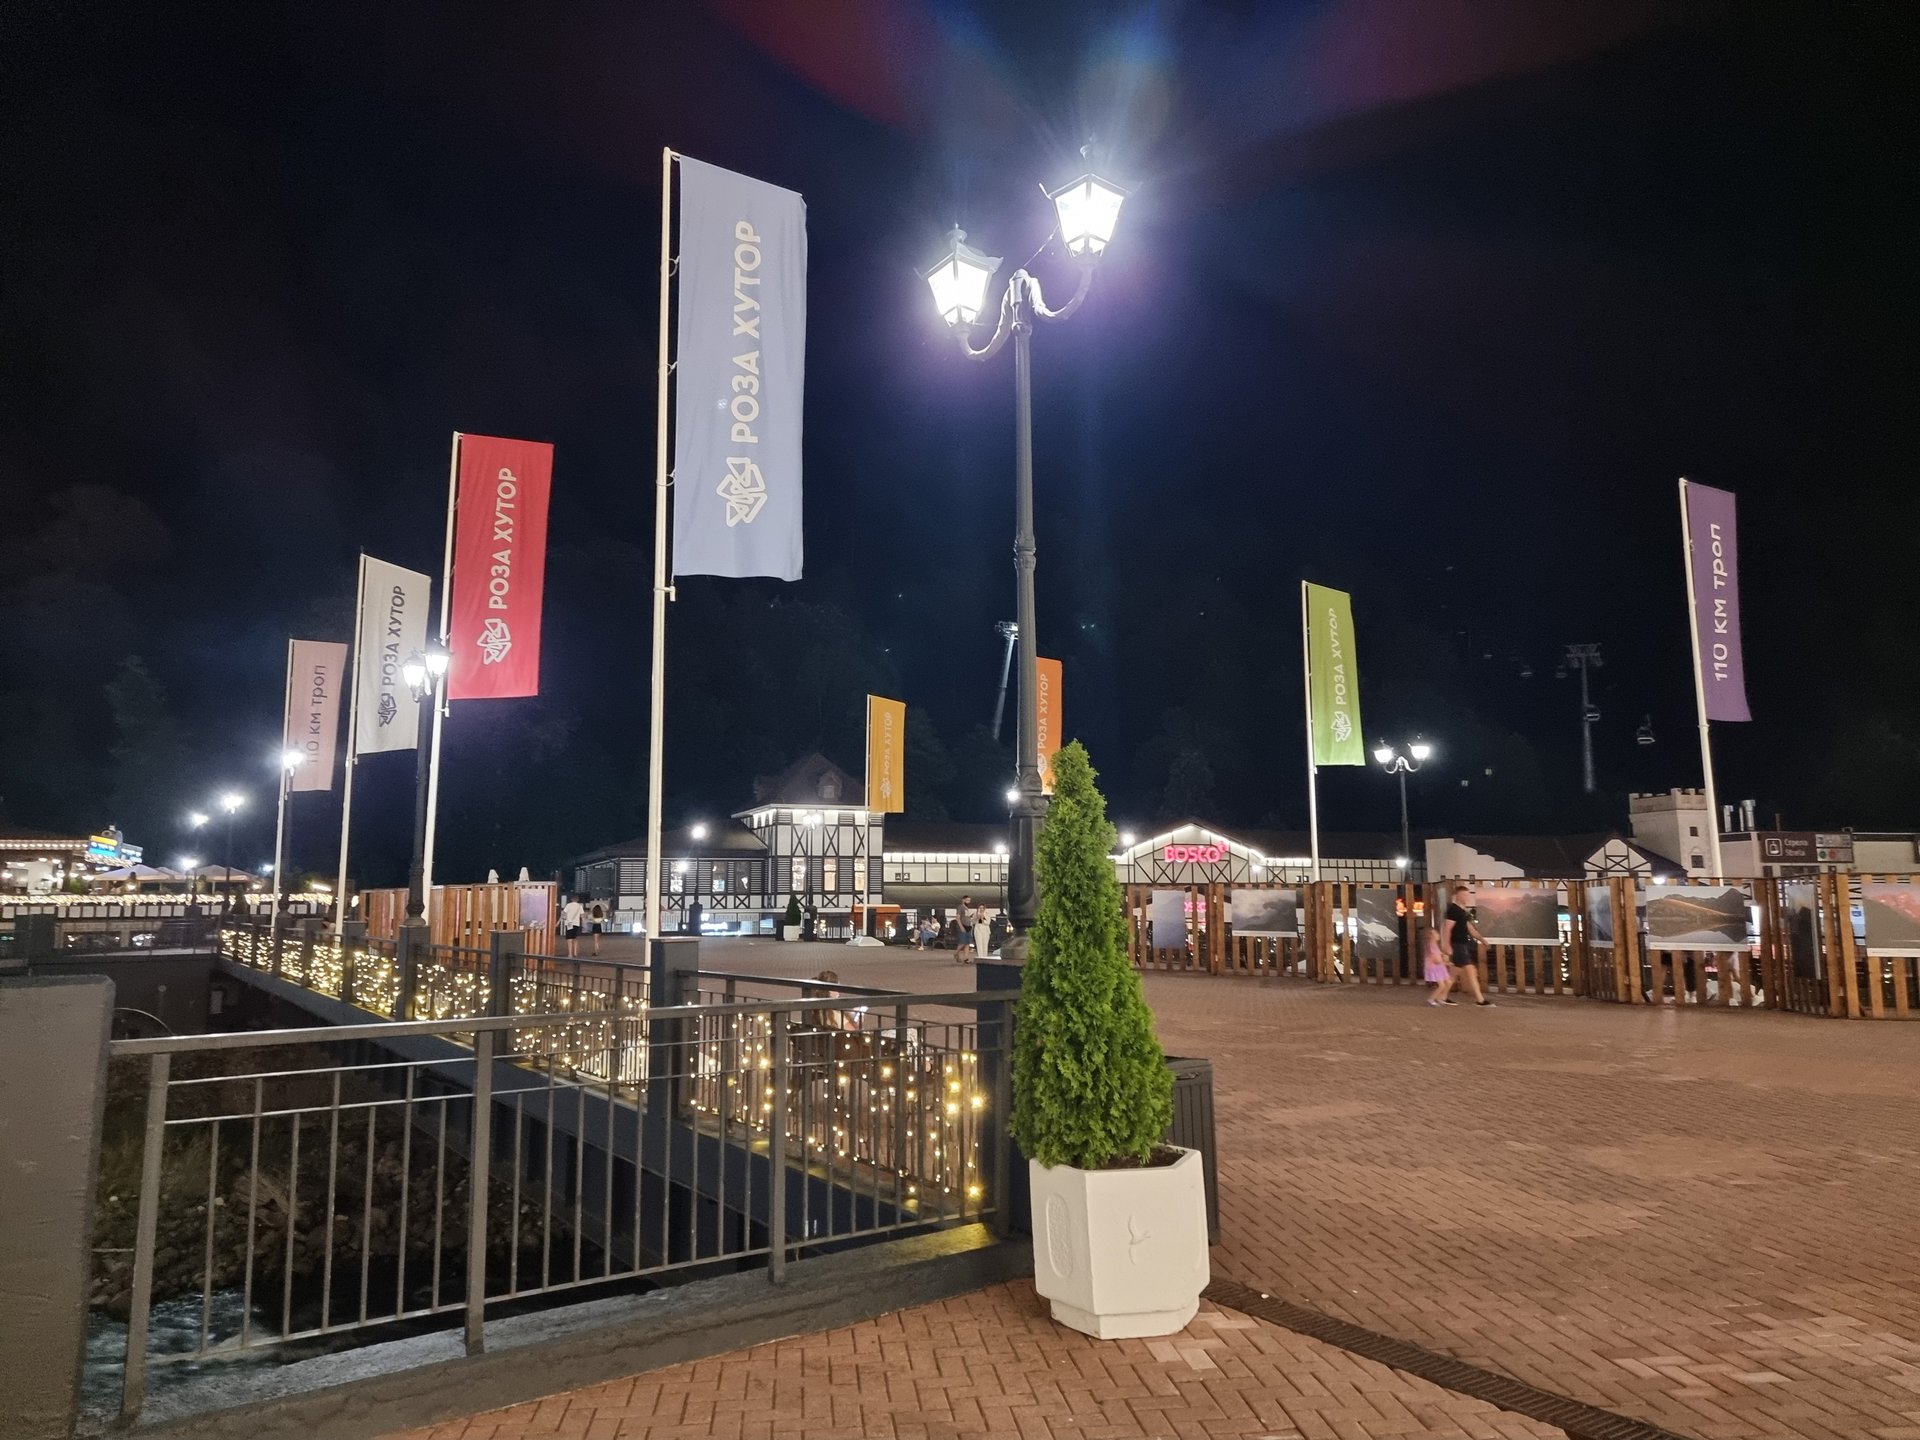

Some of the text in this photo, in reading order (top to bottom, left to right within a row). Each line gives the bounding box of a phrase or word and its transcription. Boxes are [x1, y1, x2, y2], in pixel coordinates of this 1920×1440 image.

[730, 220, 761, 444] РОЗА ХУТОР
[488, 467, 517, 610] РОЗА ХУТОР
[1710, 523, 1728, 589] троп
[382, 585, 406, 686] РОЗА ХУТОР
[1713, 643, 1728, 681] 110
[311, 665, 328, 707] троп
[1037, 673, 1049, 749] РОЗА ХУТОР
[1334, 664, 1347, 705] РОЗА
[306, 740, 320, 766] 110
[1164, 846, 1221, 863] BOSCO
